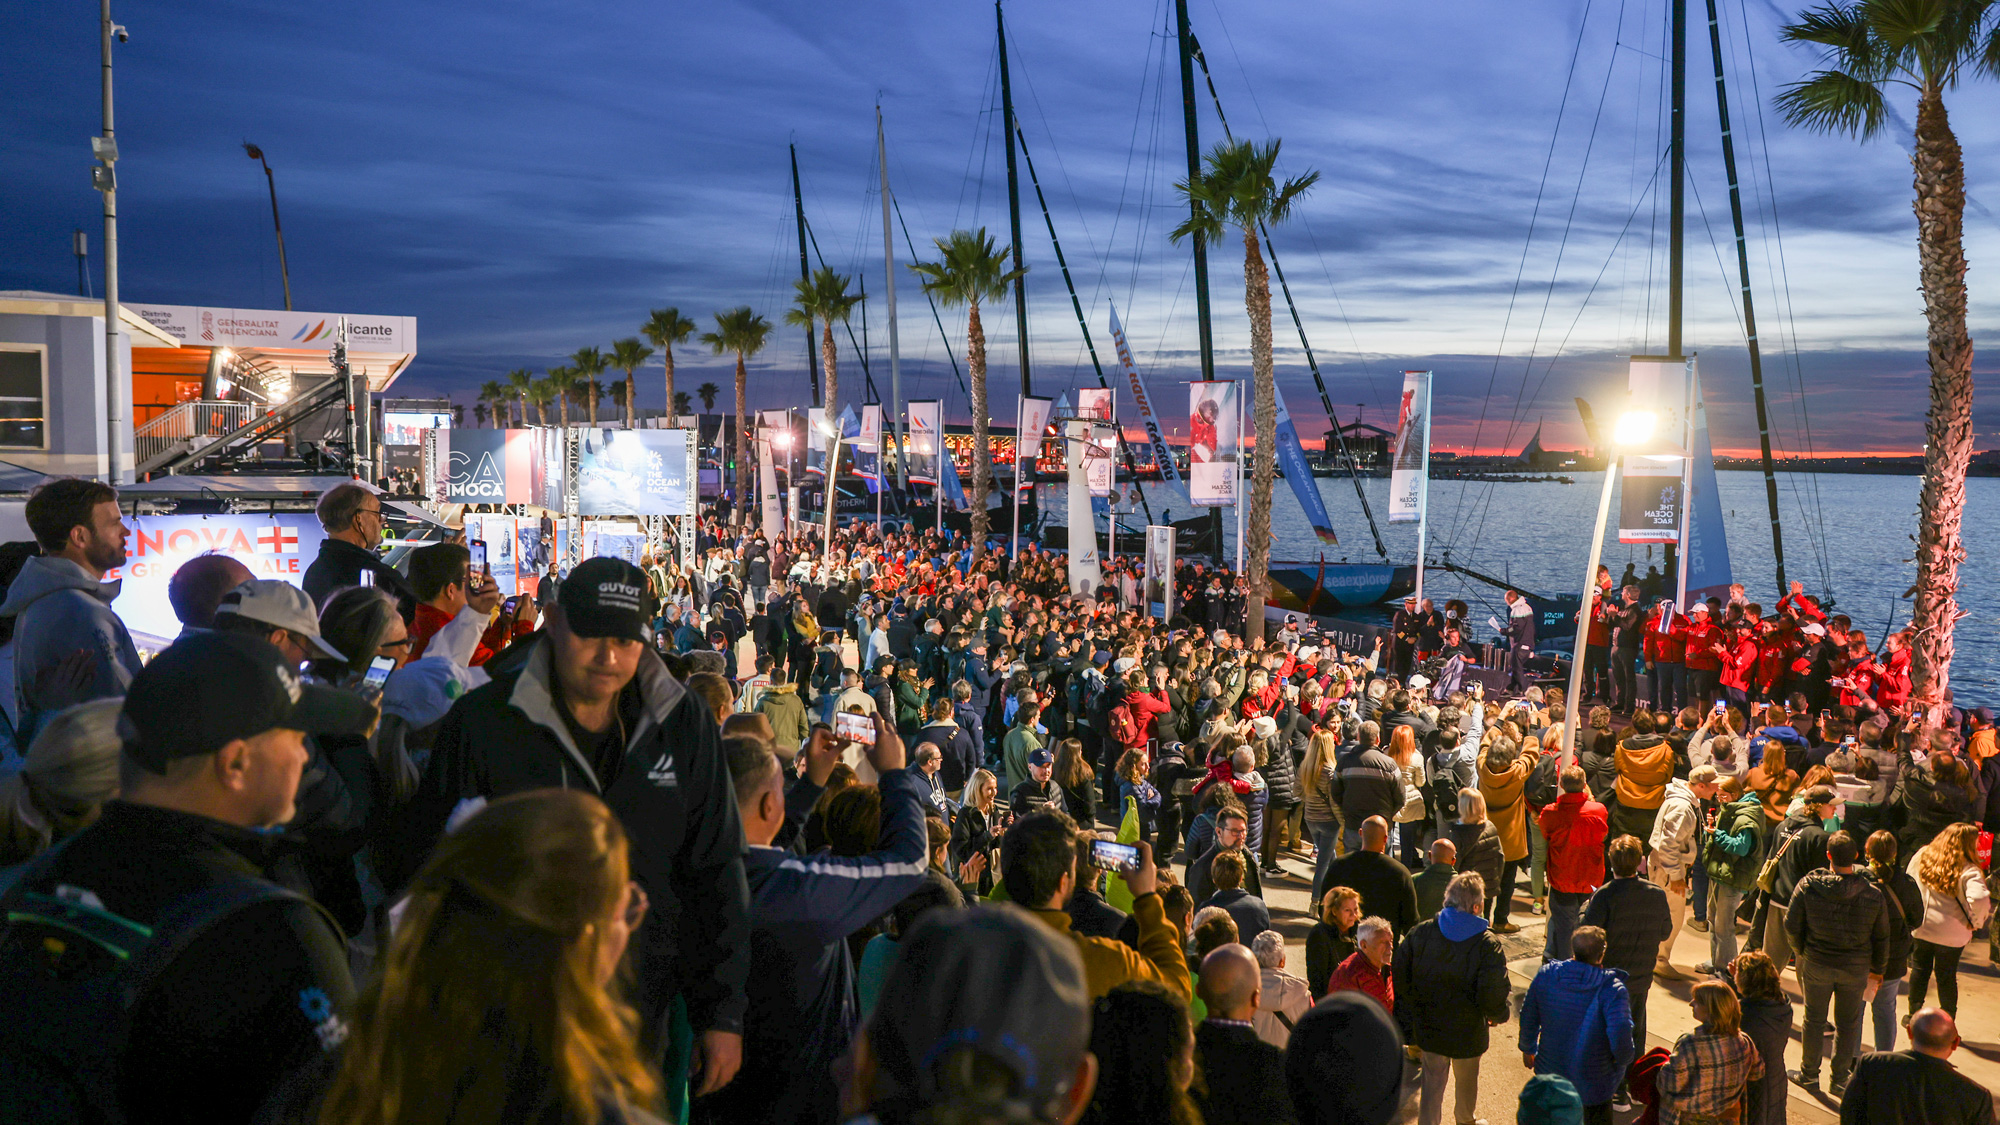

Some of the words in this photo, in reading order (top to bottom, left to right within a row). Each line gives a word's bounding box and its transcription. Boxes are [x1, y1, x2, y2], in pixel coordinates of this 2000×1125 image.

[141, 310, 172, 318] Distrito
[217, 319, 279, 328] GENERALITAT
[346, 323, 393, 336] licante
[218, 327, 278, 337] VALENCIANA
[1129, 372, 1152, 417] HOUR
[1285, 442, 1298, 461] THE
[1294, 459, 1312, 492] OCEAN
[646, 478, 680, 486] OCEAN
[446, 484, 504, 497] IMOCA
[836, 498, 866, 508] OTHERM
[1690, 538, 1706, 575] RACE
[1325, 571, 1390, 590] seaexplorer
[598, 582, 641, 597] GUYOT
